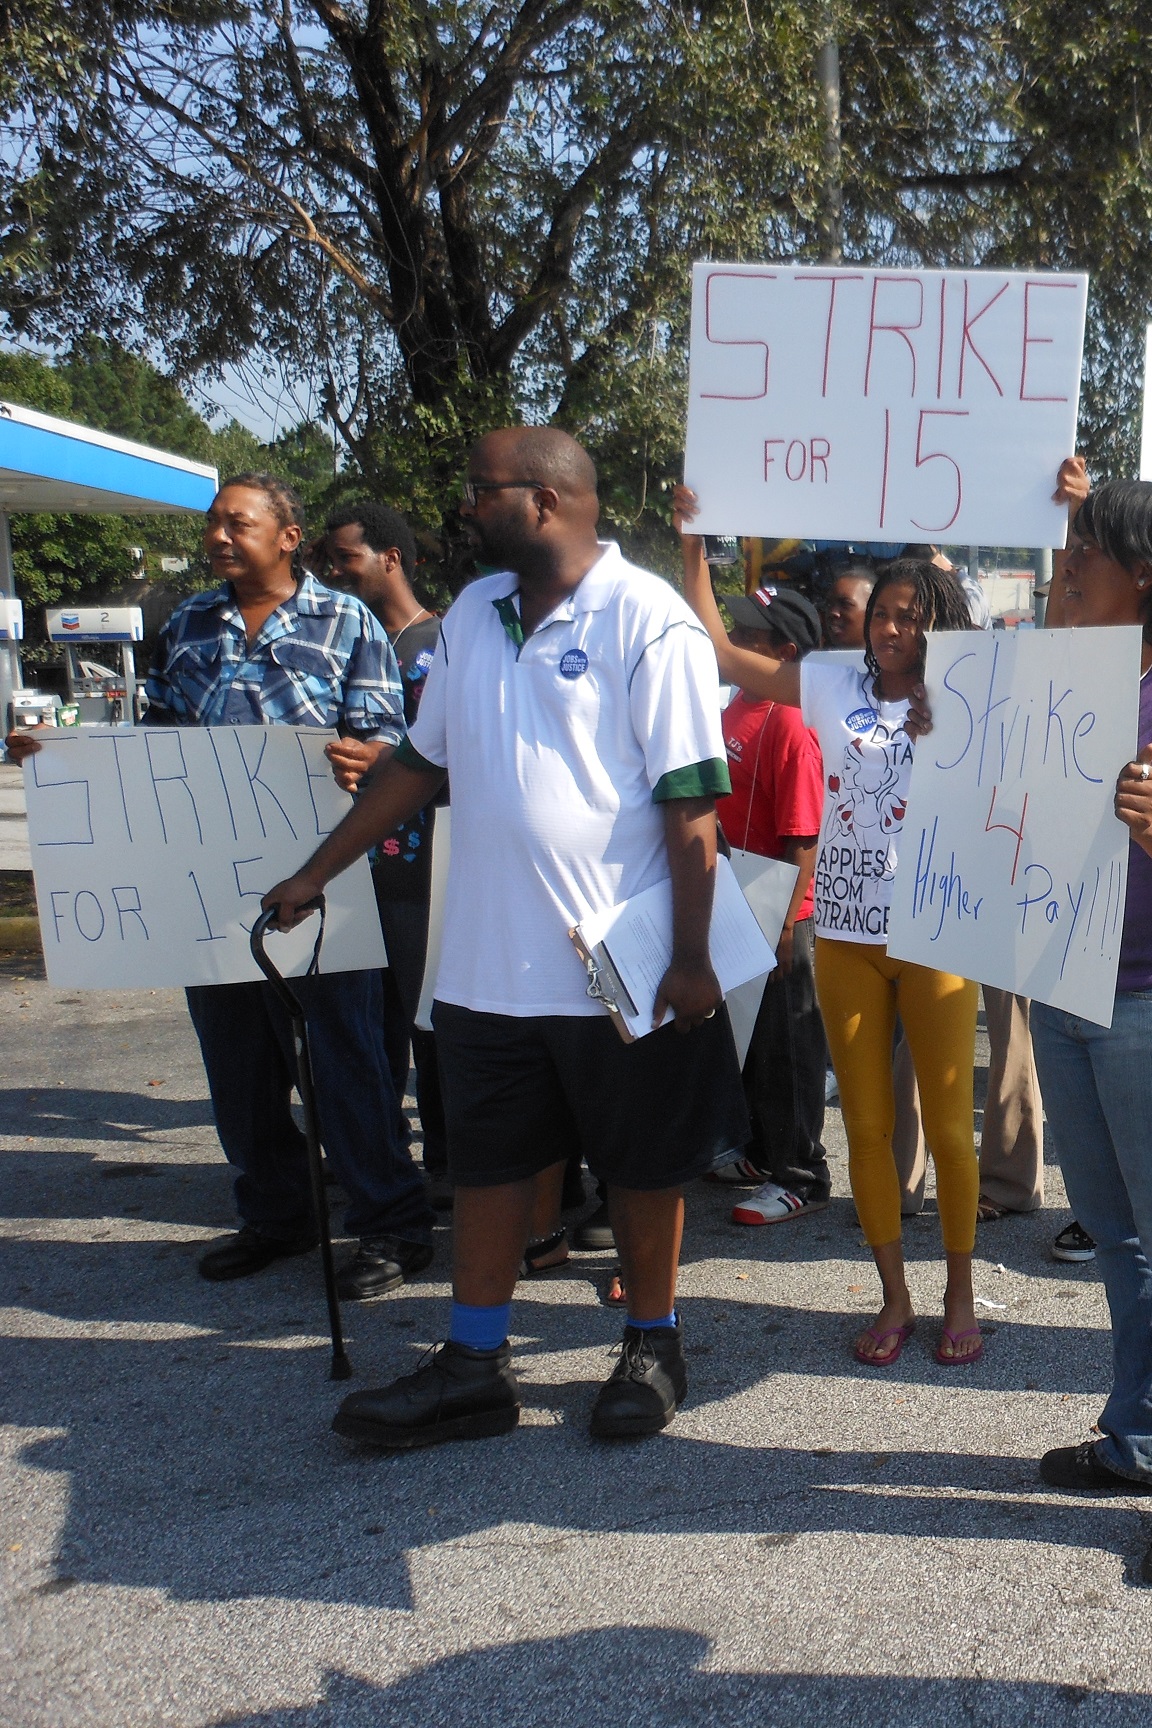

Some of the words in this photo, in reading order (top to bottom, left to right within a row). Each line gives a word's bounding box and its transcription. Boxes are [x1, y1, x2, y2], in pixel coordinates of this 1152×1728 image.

[700, 273, 1077, 401] STRIKE
[764, 439, 831, 483] FOR
[880, 409, 969, 532] 15
[100, 612, 109, 622] 2
[561, 664, 585, 672] JUSTICE
[563, 654, 578, 663] JOBS
[848, 712, 864, 724] JOBS
[850, 715, 877, 730] JUSTICE
[34, 727, 337, 846] STRIKE
[986, 785, 1028, 886] 4
[818, 845, 885, 877] APPLES
[815, 871, 864, 903] FROM
[913, 816, 983, 941] Higher
[50, 886, 149, 943] FOR
